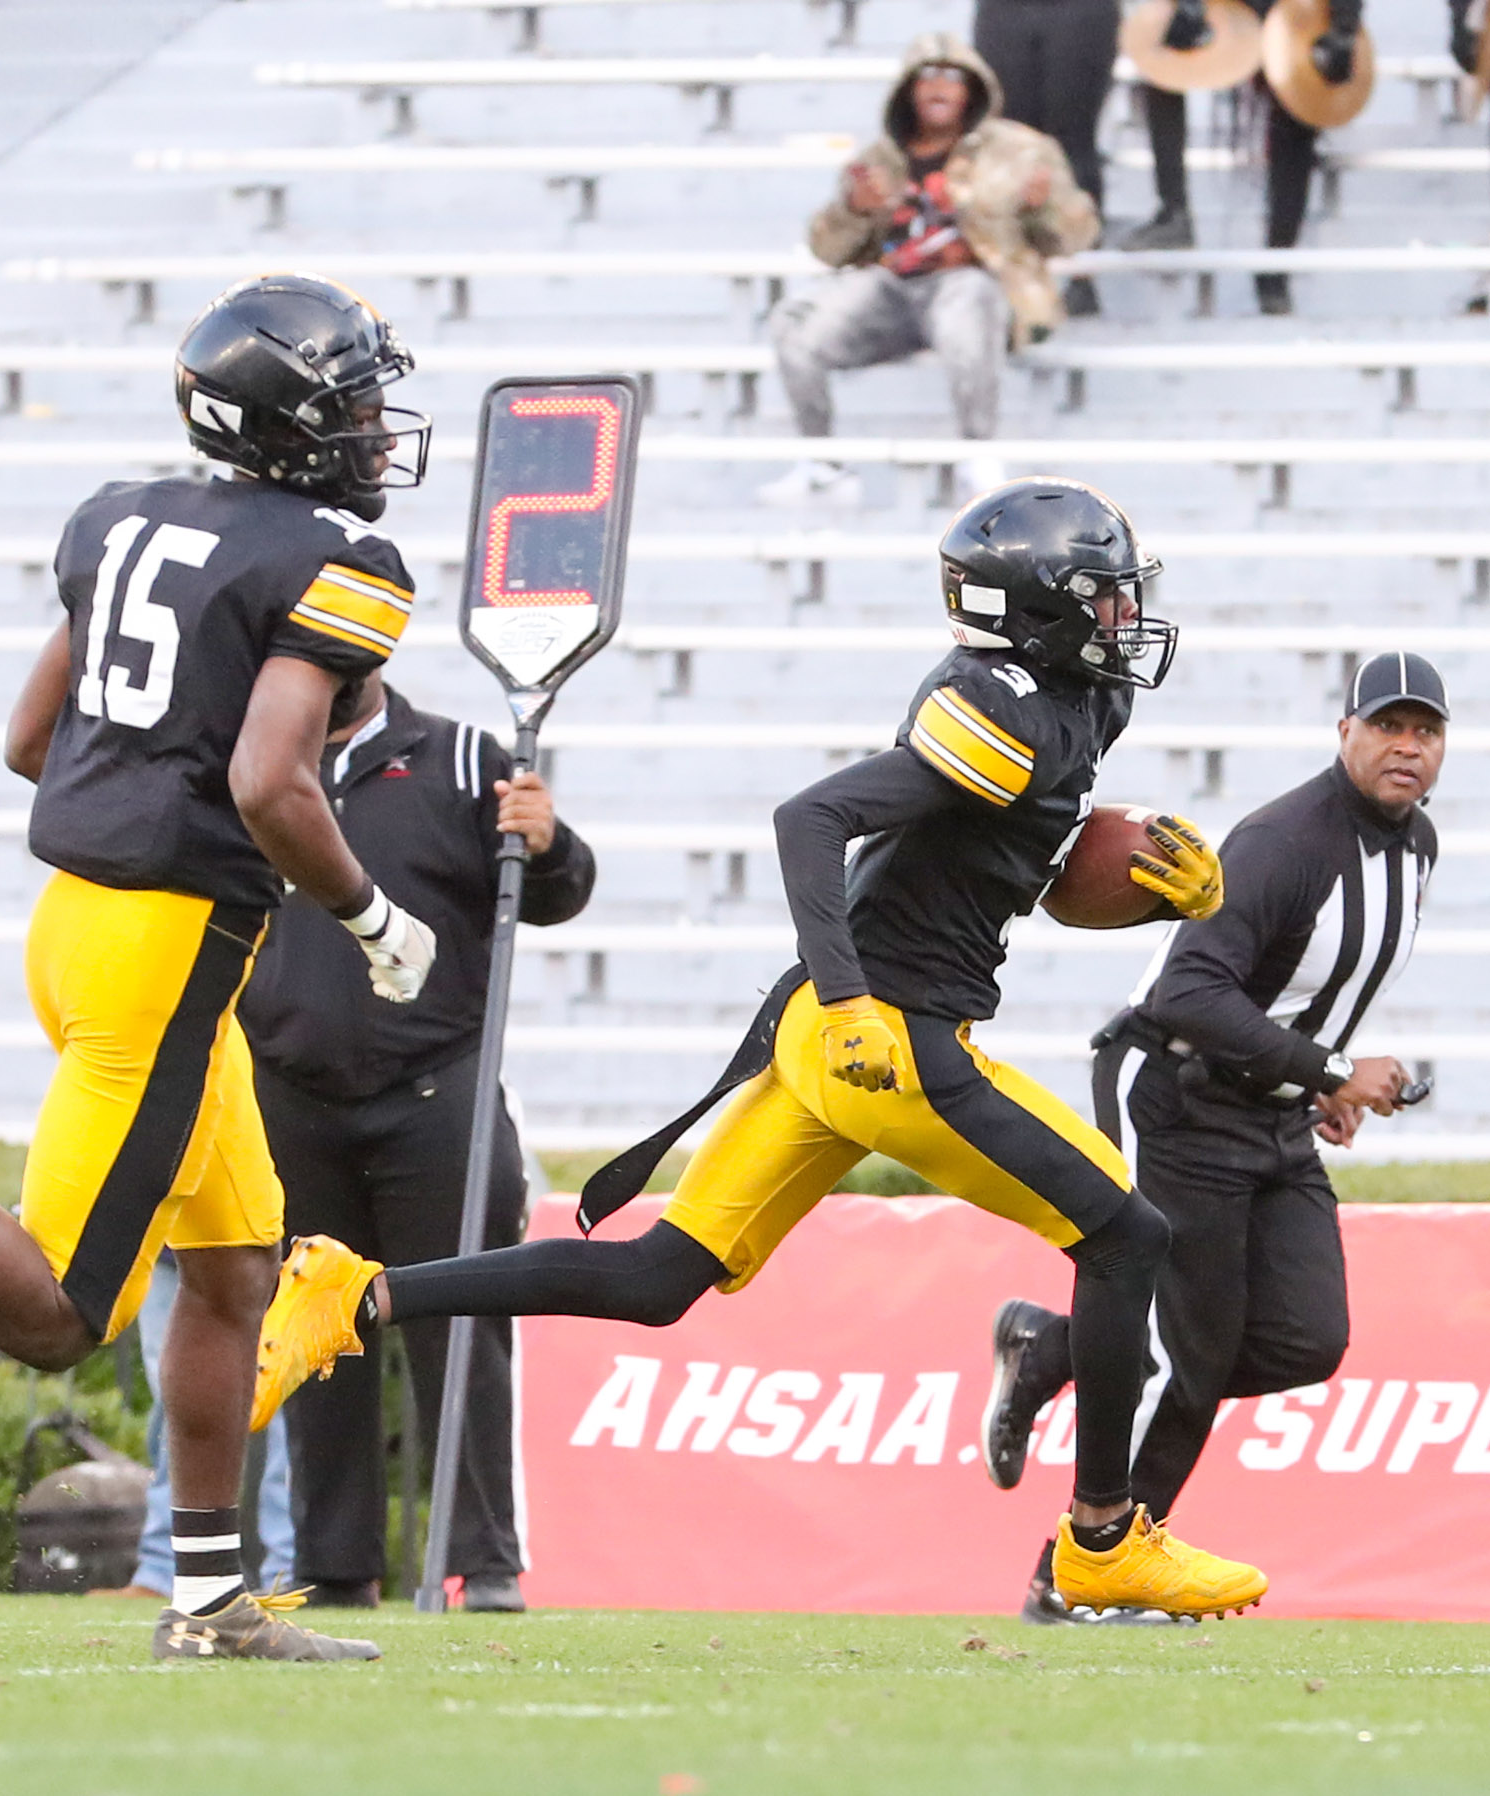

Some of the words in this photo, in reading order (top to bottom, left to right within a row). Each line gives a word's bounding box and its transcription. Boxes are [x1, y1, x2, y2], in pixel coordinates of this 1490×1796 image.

[482, 397, 622, 607] 2
[77, 514, 221, 730] 15
[991, 663, 1038, 698] 3
